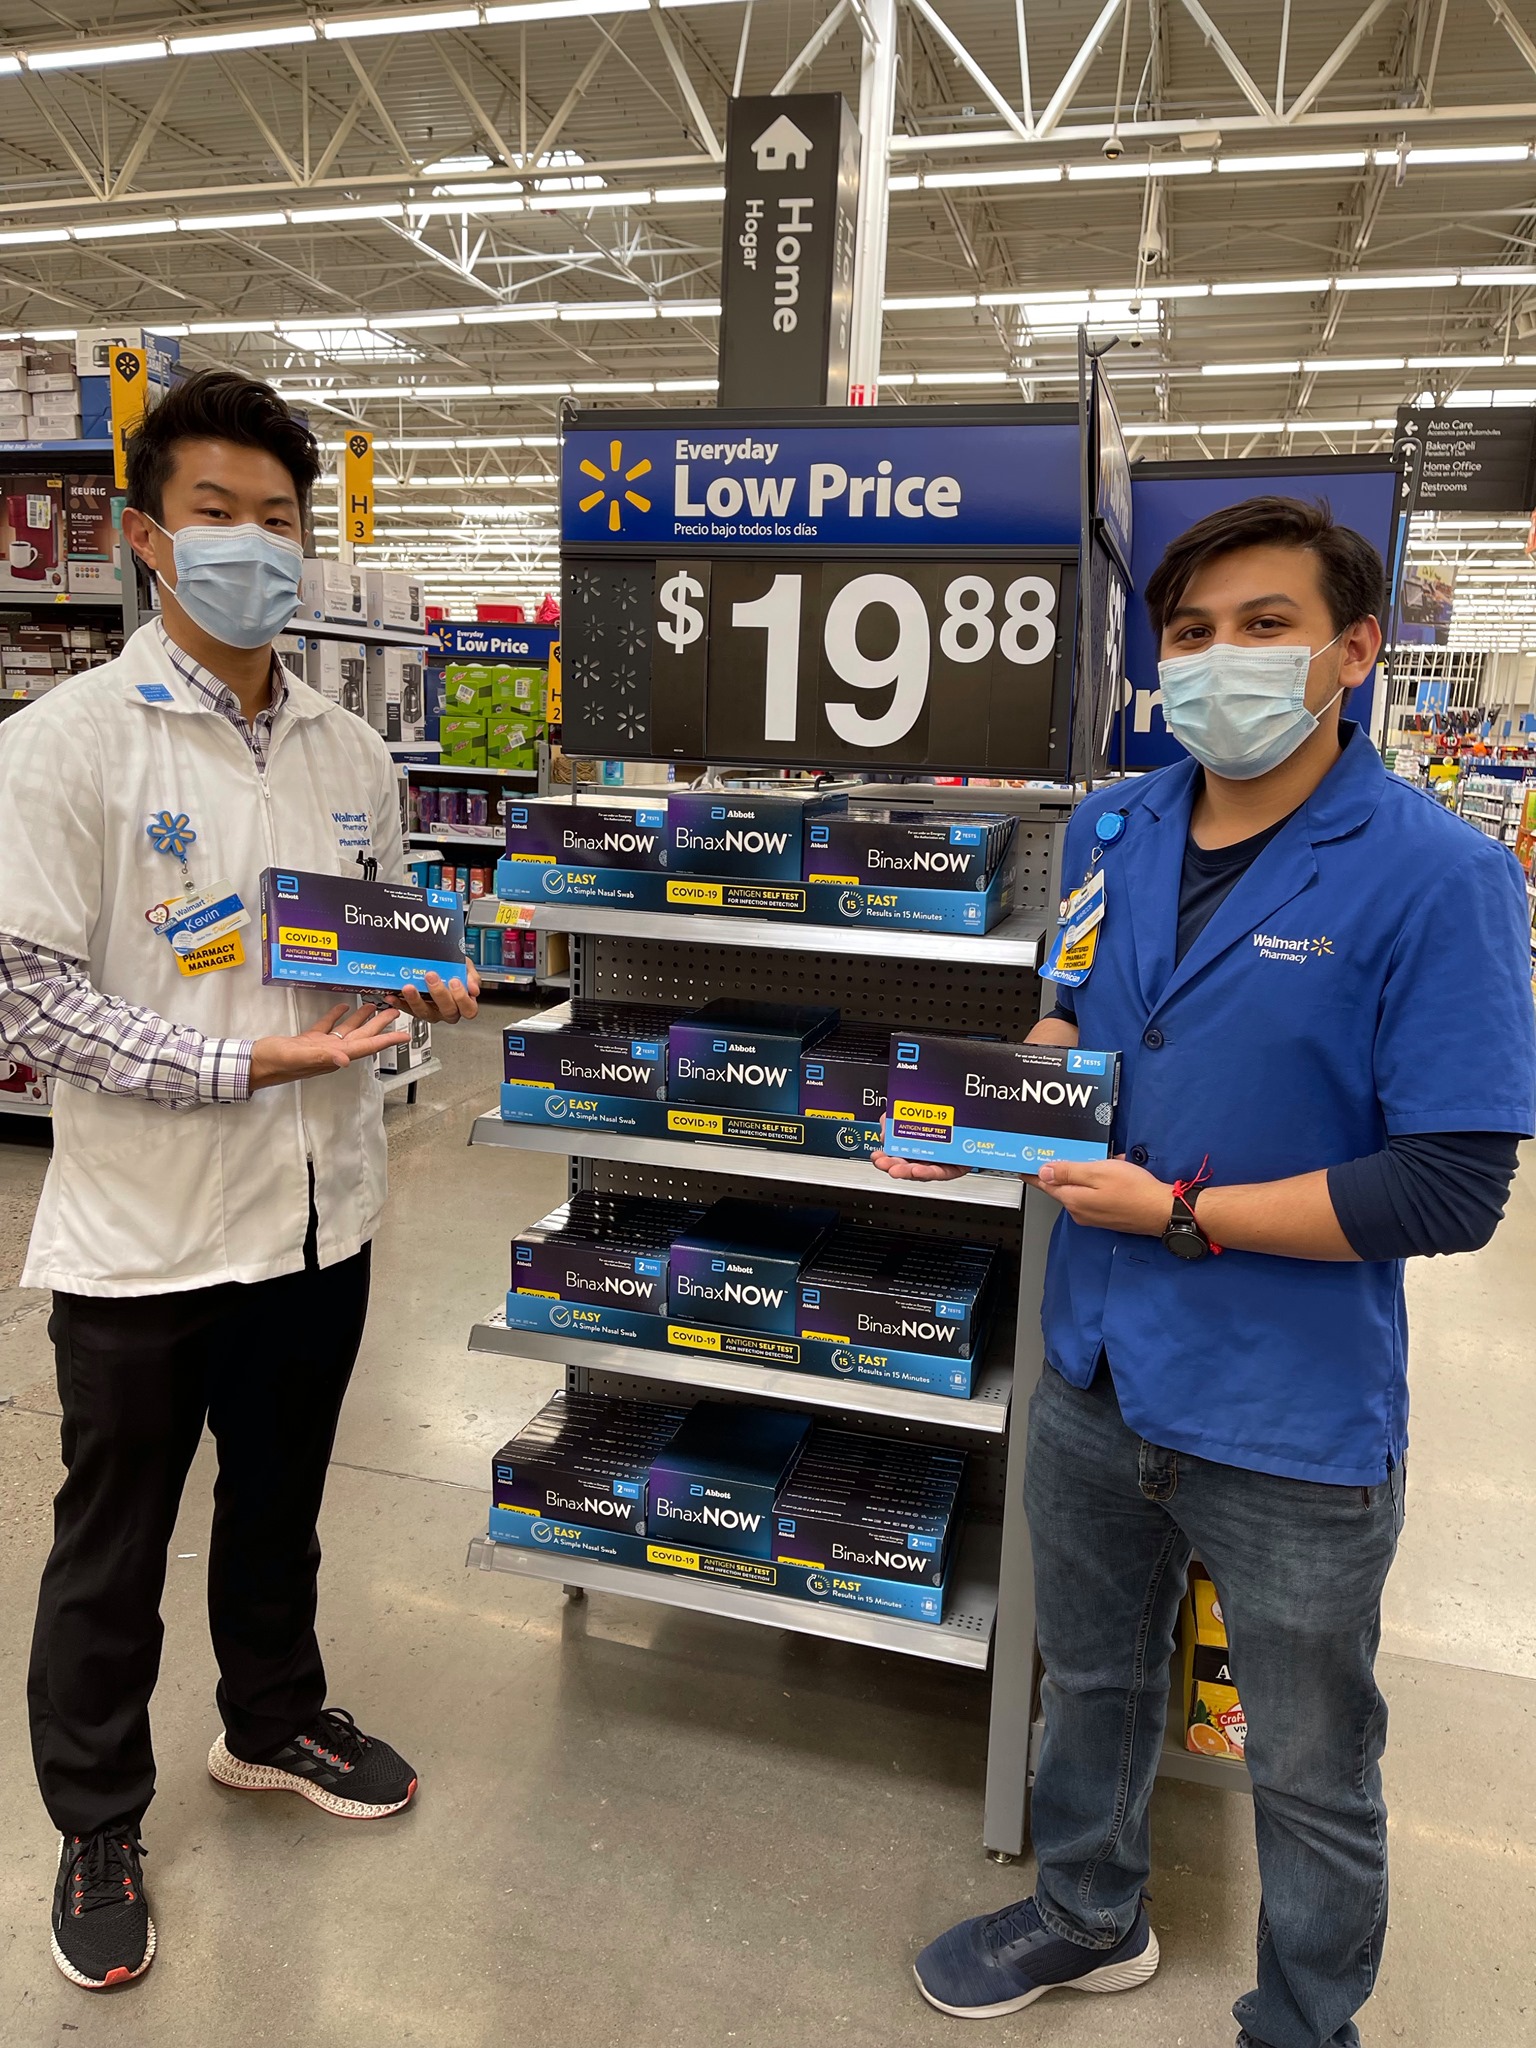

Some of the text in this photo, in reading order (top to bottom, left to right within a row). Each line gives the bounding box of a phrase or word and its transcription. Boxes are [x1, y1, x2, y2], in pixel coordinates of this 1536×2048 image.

[739, 199, 764, 271] Hogar
[773, 197, 814, 334] Home
[1427, 420, 1474, 430] Auto Care
[675, 438, 779, 466] Everyday
[1425, 441, 1476, 452] Bakery/Deli
[1423, 461, 1482, 472] Home Office
[71, 486, 106, 496] KEURIG
[675, 460, 962, 519] Low Price
[1420, 482, 1468, 492] Restrooms
[351, 494, 368, 514] H
[71, 512, 103, 522] K-Express
[354, 520, 365, 538] 3
[674, 522, 818, 538] Precio bajo todos los días
[456, 630, 484, 639] Everyday
[456, 636, 529, 654] Low Price
[553, 708, 560, 720] 2
[331, 812, 367, 823] Walmart
[727, 810, 755, 819] Abbott
[563, 830, 655, 854] BinaxNOW
[675, 827, 788, 855] BinaxNOW
[954, 830, 962, 841] 2
[868, 849, 971, 873] BinaxNOW
[567, 872, 597, 886] EASY
[278, 892, 299, 900] Abbott
[431, 893, 439, 904] 2
[567, 885, 634, 899] A Simple Nasal Swab
[672, 887, 718, 899] COVID-19
[728, 889, 799, 900] ANTIGEN SELF TEST
[175, 898, 206, 917] Walmart
[769, 900, 799, 908] DETECTION
[846, 900, 857, 909] 15
[867, 894, 898, 907] FAST
[184, 908, 220, 931] Kevin
[344, 904, 450, 936] BinaxNOW
[866, 909, 942, 921] Results in 15 Minutes
[285, 932, 332, 945] COVID-19
[1253, 933, 1310, 951] Walmart
[182, 943, 235, 962] PHARMACY
[1259, 948, 1308, 964] Pharmacy
[188, 953, 236, 971] MANAGER
[1050, 967, 1080, 983] Technician
[728, 1043, 756, 1053] Abbott
[896, 1062, 918, 1071] Abbott
[1072, 1055, 1101, 1068] 2 TESTS
[560, 1059, 651, 1084] BinaxNOW
[678, 1057, 788, 1088] BinaxNOW
[964, 1072, 1094, 1109] BinaxNOW
[569, 1099, 599, 1111] EASY
[576, 1112, 598, 1122] Simple
[600, 1115, 617, 1123] Nasal
[619, 1116, 636, 1125] Swab
[900, 1106, 948, 1121] COVID-19
[672, 1116, 718, 1128] COVID-19
[728, 1120, 798, 1133] ANTIGEN SELF TEST
[739, 1129, 767, 1137] INFECTION
[768, 1132, 798, 1140] DETECTION
[843, 1135, 854, 1144] 15
[977, 1141, 995, 1149] EASY
[726, 1264, 754, 1275] Abbott
[566, 1270, 653, 1299] BinaxNOW
[677, 1275, 783, 1309] BinaxNOW
[572, 1309, 601, 1323] EASY
[579, 1322, 600, 1334] Simple
[602, 1326, 619, 1336] Nasal
[620, 1328, 637, 1338] Swab
[857, 1313, 957, 1343] BinaxNOW
[672, 1331, 716, 1345] COVID-19
[726, 1338, 794, 1353] ANTIGEN SELF TEST
[737, 1347, 764, 1355] INFECTION
[764, 1351, 794, 1360] DETECTION
[838, 1357, 849, 1367] 15
[858, 1354, 888, 1368] FAST
[858, 1366, 930, 1384] Results in 15 Minutes
[704, 1488, 732, 1499] Abbott
[546, 1490, 632, 1520] BinaxNOW
[656, 1497, 761, 1533] BinaxNOW
[553, 1526, 582, 1540] EASY
[560, 1539, 581, 1550] Simple
[582, 1543, 600, 1552] Nasal
[600, 1546, 617, 1556] Swab
[911, 1538, 918, 1548] 2
[651, 1550, 695, 1565] COVID-19
[832, 1543, 928, 1573] BinaxNOW
[704, 1558, 770, 1576] ANTIGEN SELF TEST
[715, 1567, 742, 1577] INFECTION
[742, 1572, 770, 1582] DETECTION
[813, 1580, 824, 1590] 15
[833, 1579, 861, 1593] FAST
[832, 1590, 902, 1609] Results in 15 Minutes
